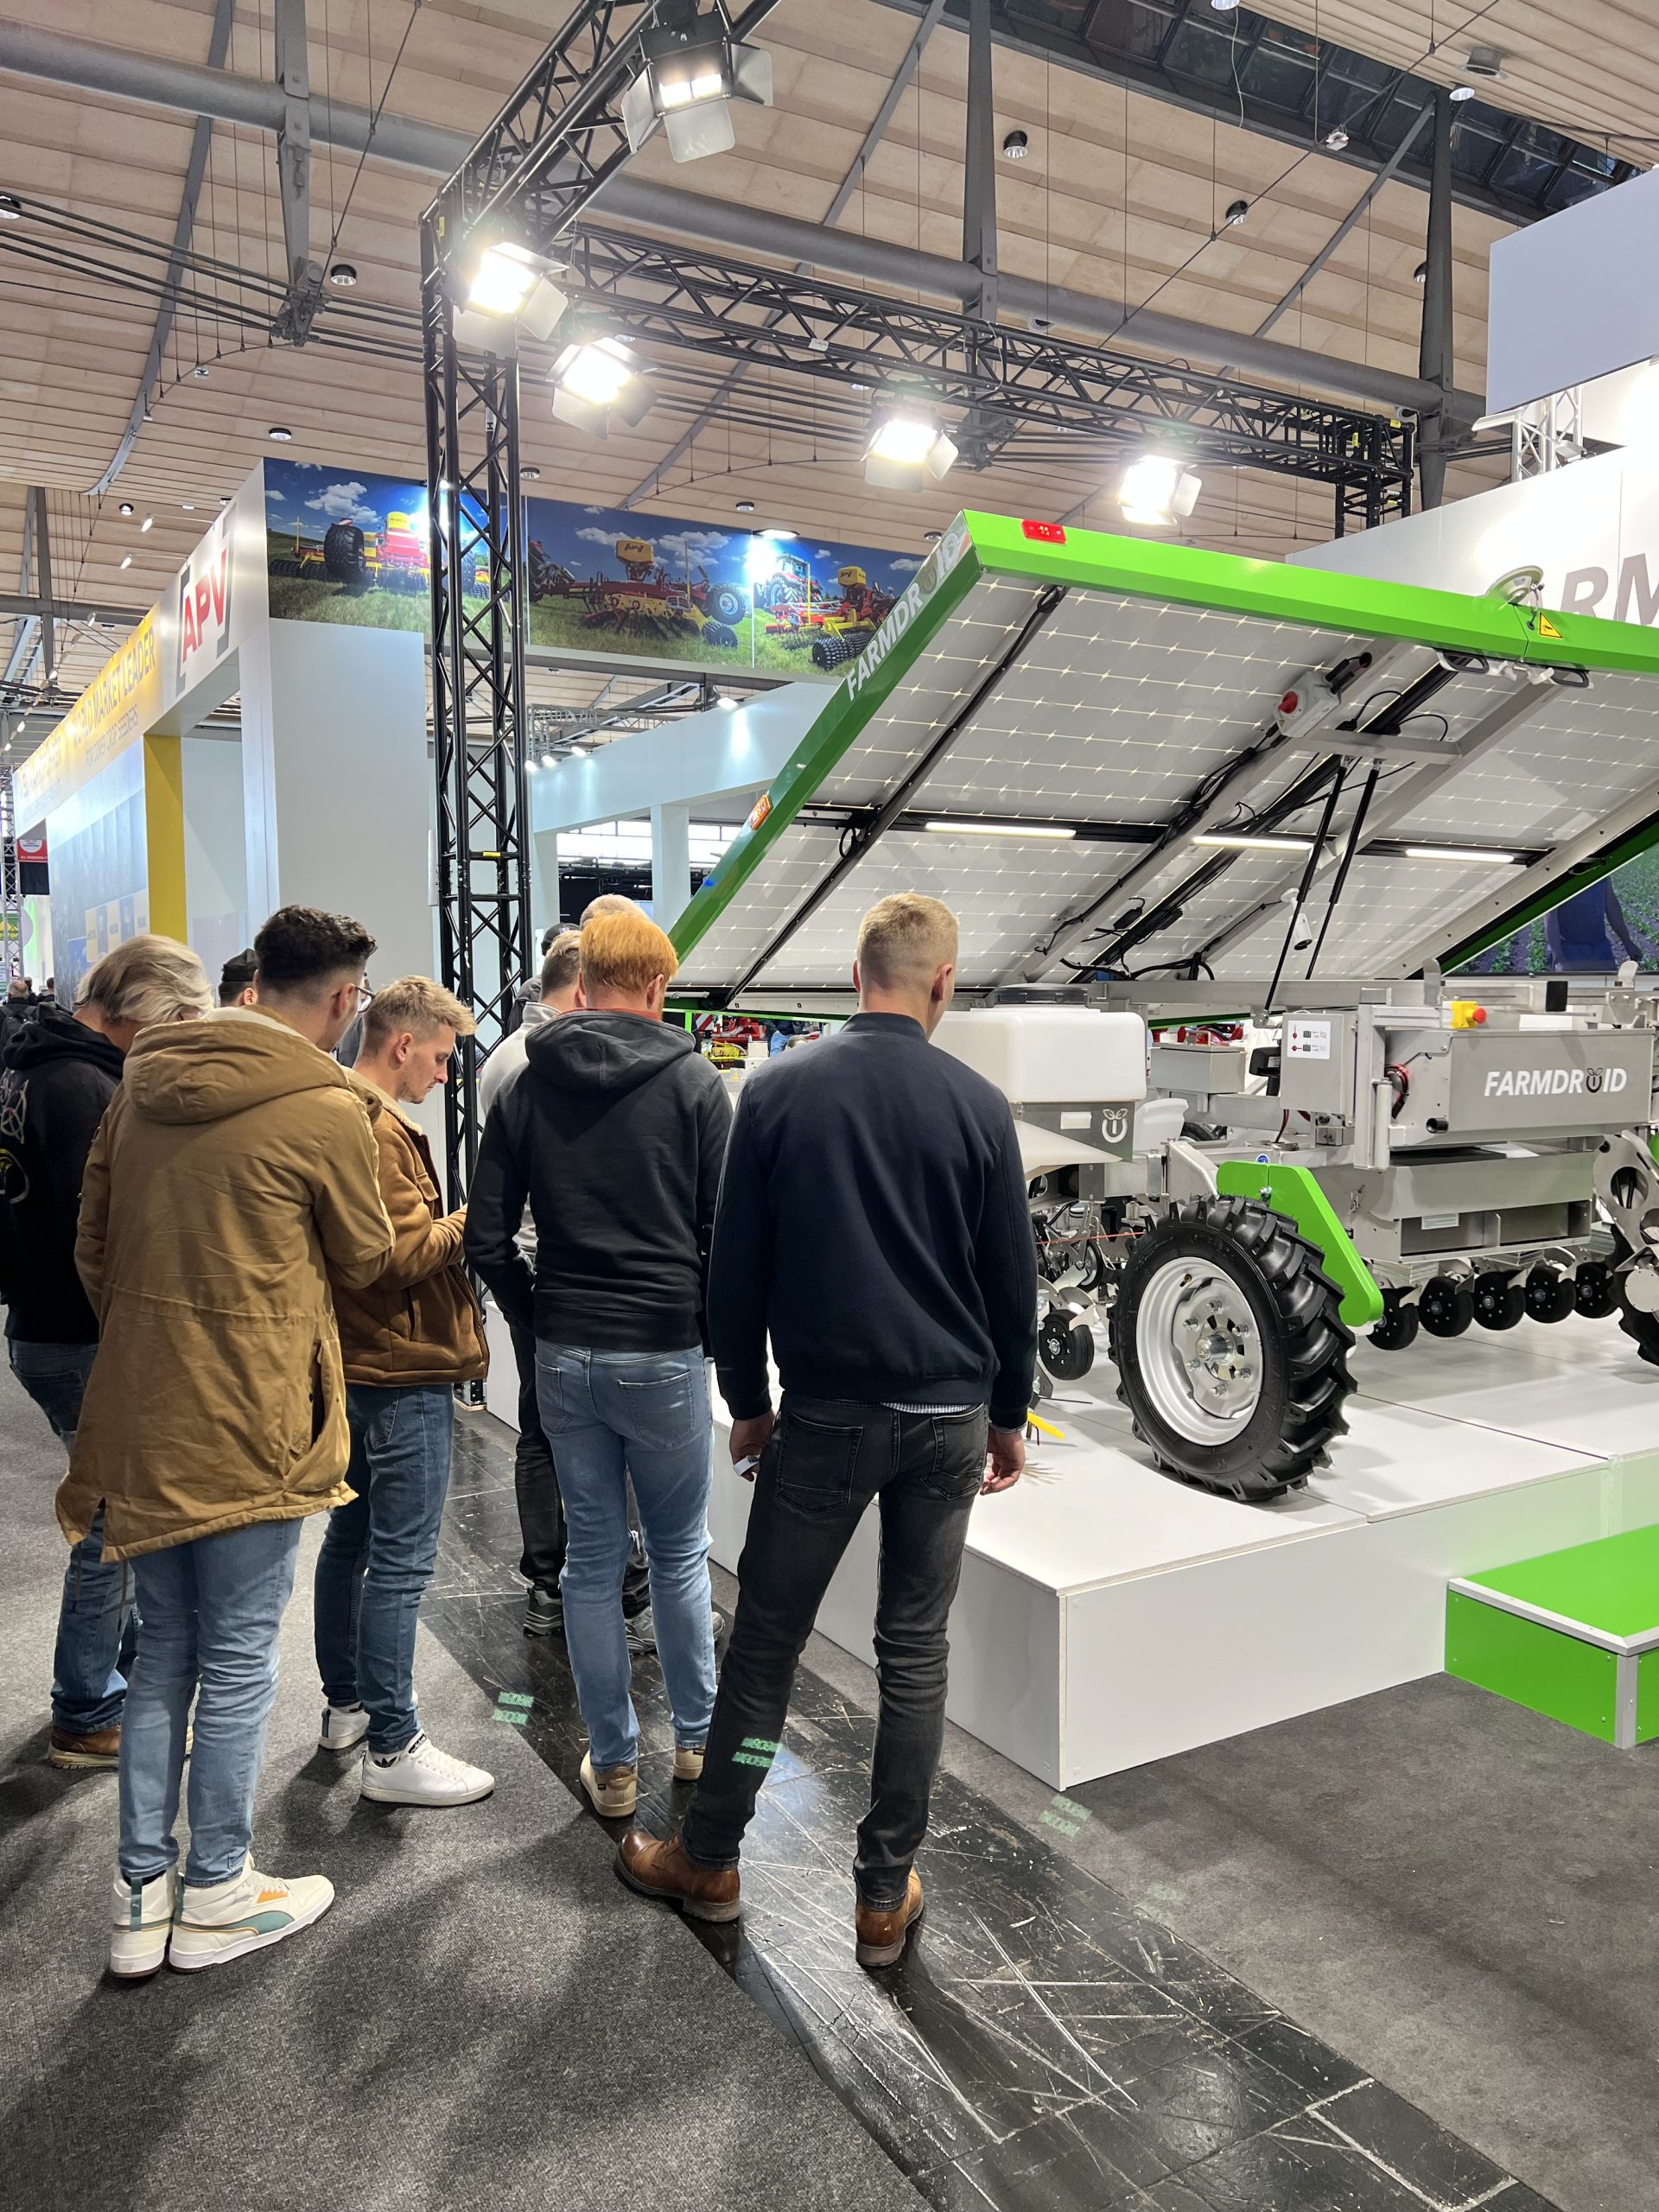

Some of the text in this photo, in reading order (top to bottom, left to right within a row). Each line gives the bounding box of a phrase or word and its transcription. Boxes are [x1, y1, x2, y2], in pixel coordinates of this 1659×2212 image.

[182, 548, 226, 664] APV
[93, 665, 121, 726] MARKET
[124, 627, 156, 696] LEADER
